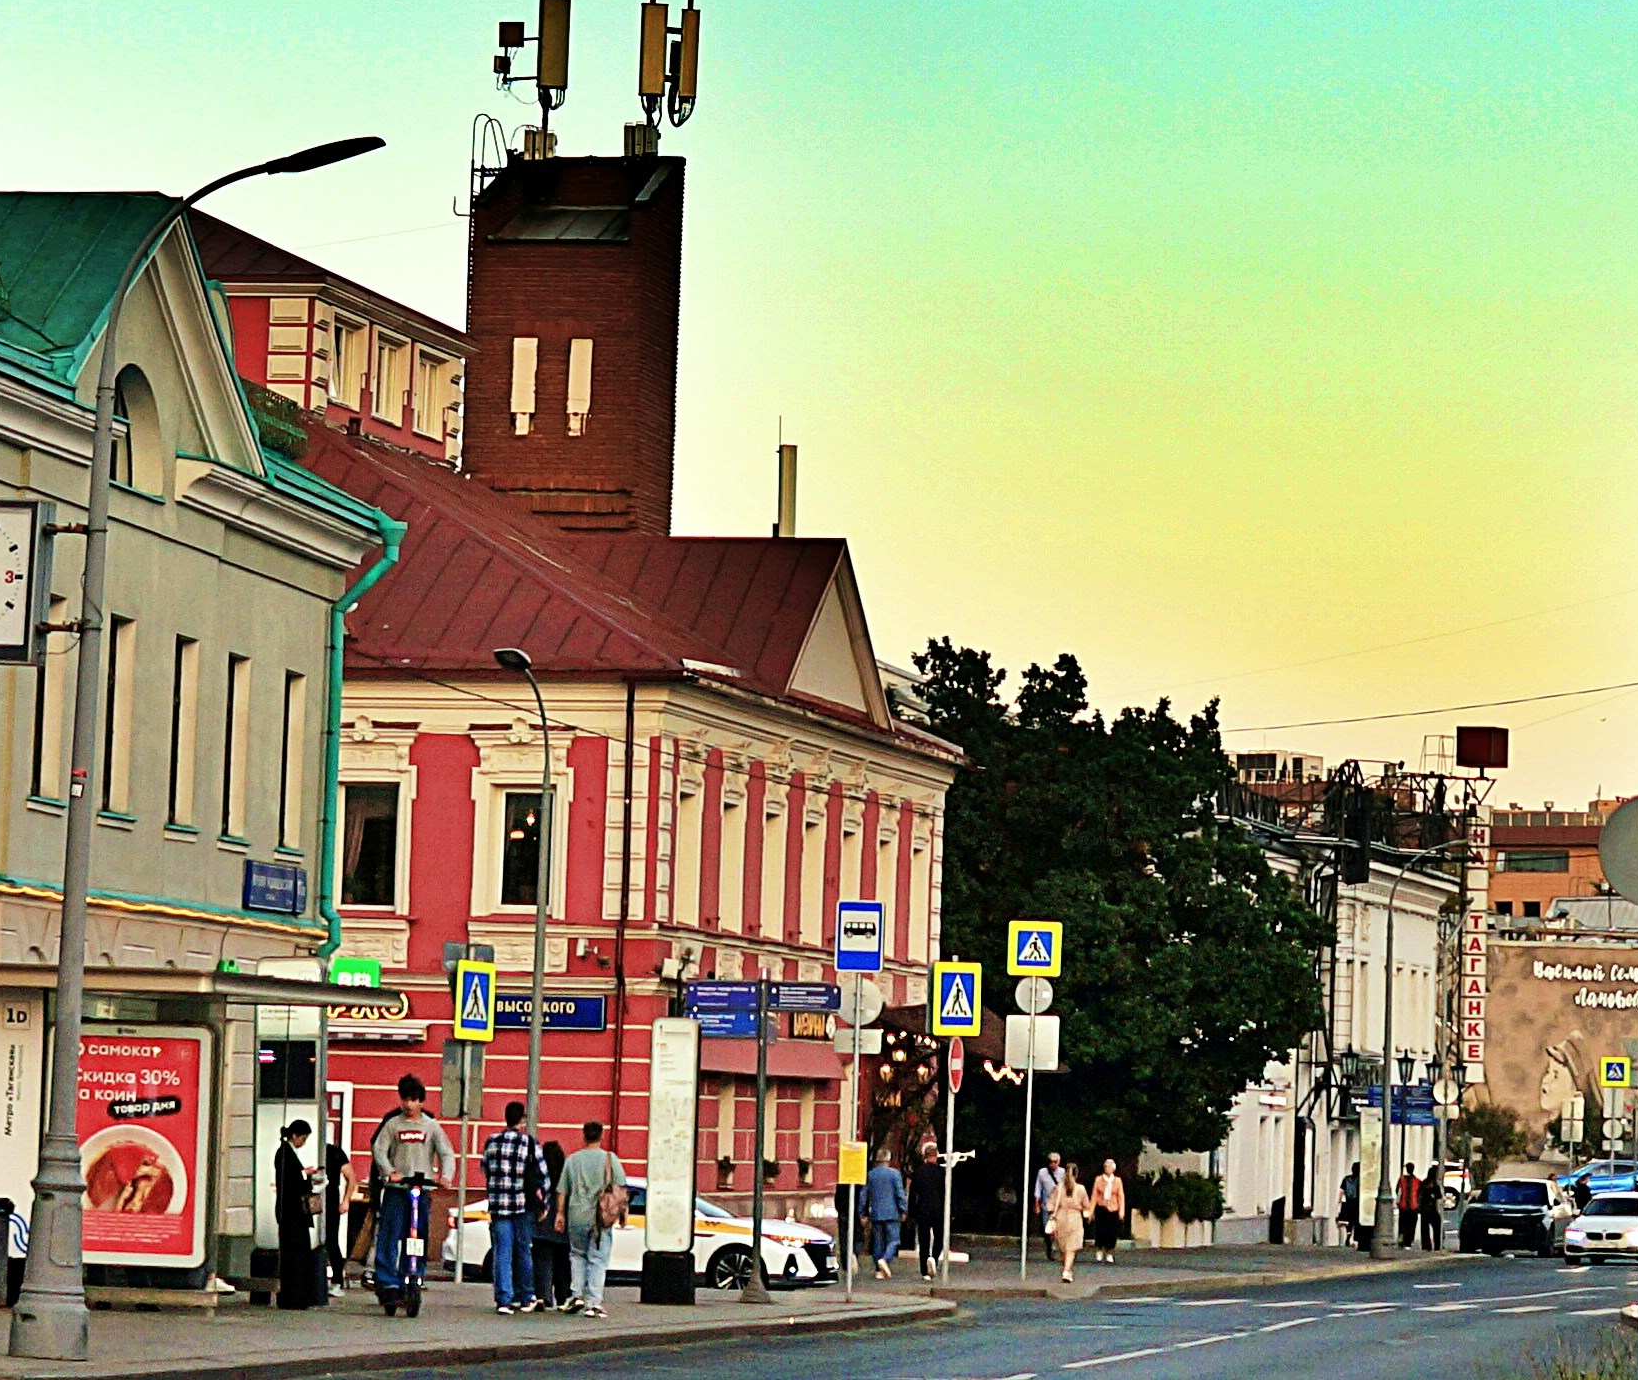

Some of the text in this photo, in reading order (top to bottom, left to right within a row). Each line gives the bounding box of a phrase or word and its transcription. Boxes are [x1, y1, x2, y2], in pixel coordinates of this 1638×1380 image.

[4, 570, 15, 584] 3
[1468, 914, 1483, 1059] ТАГАНКЕ
[496, 1001, 576, 1014] ВЫСОКОГО
[140, 1069, 181, 1086] 30%
[4, 1103, 14, 1136] Метро
